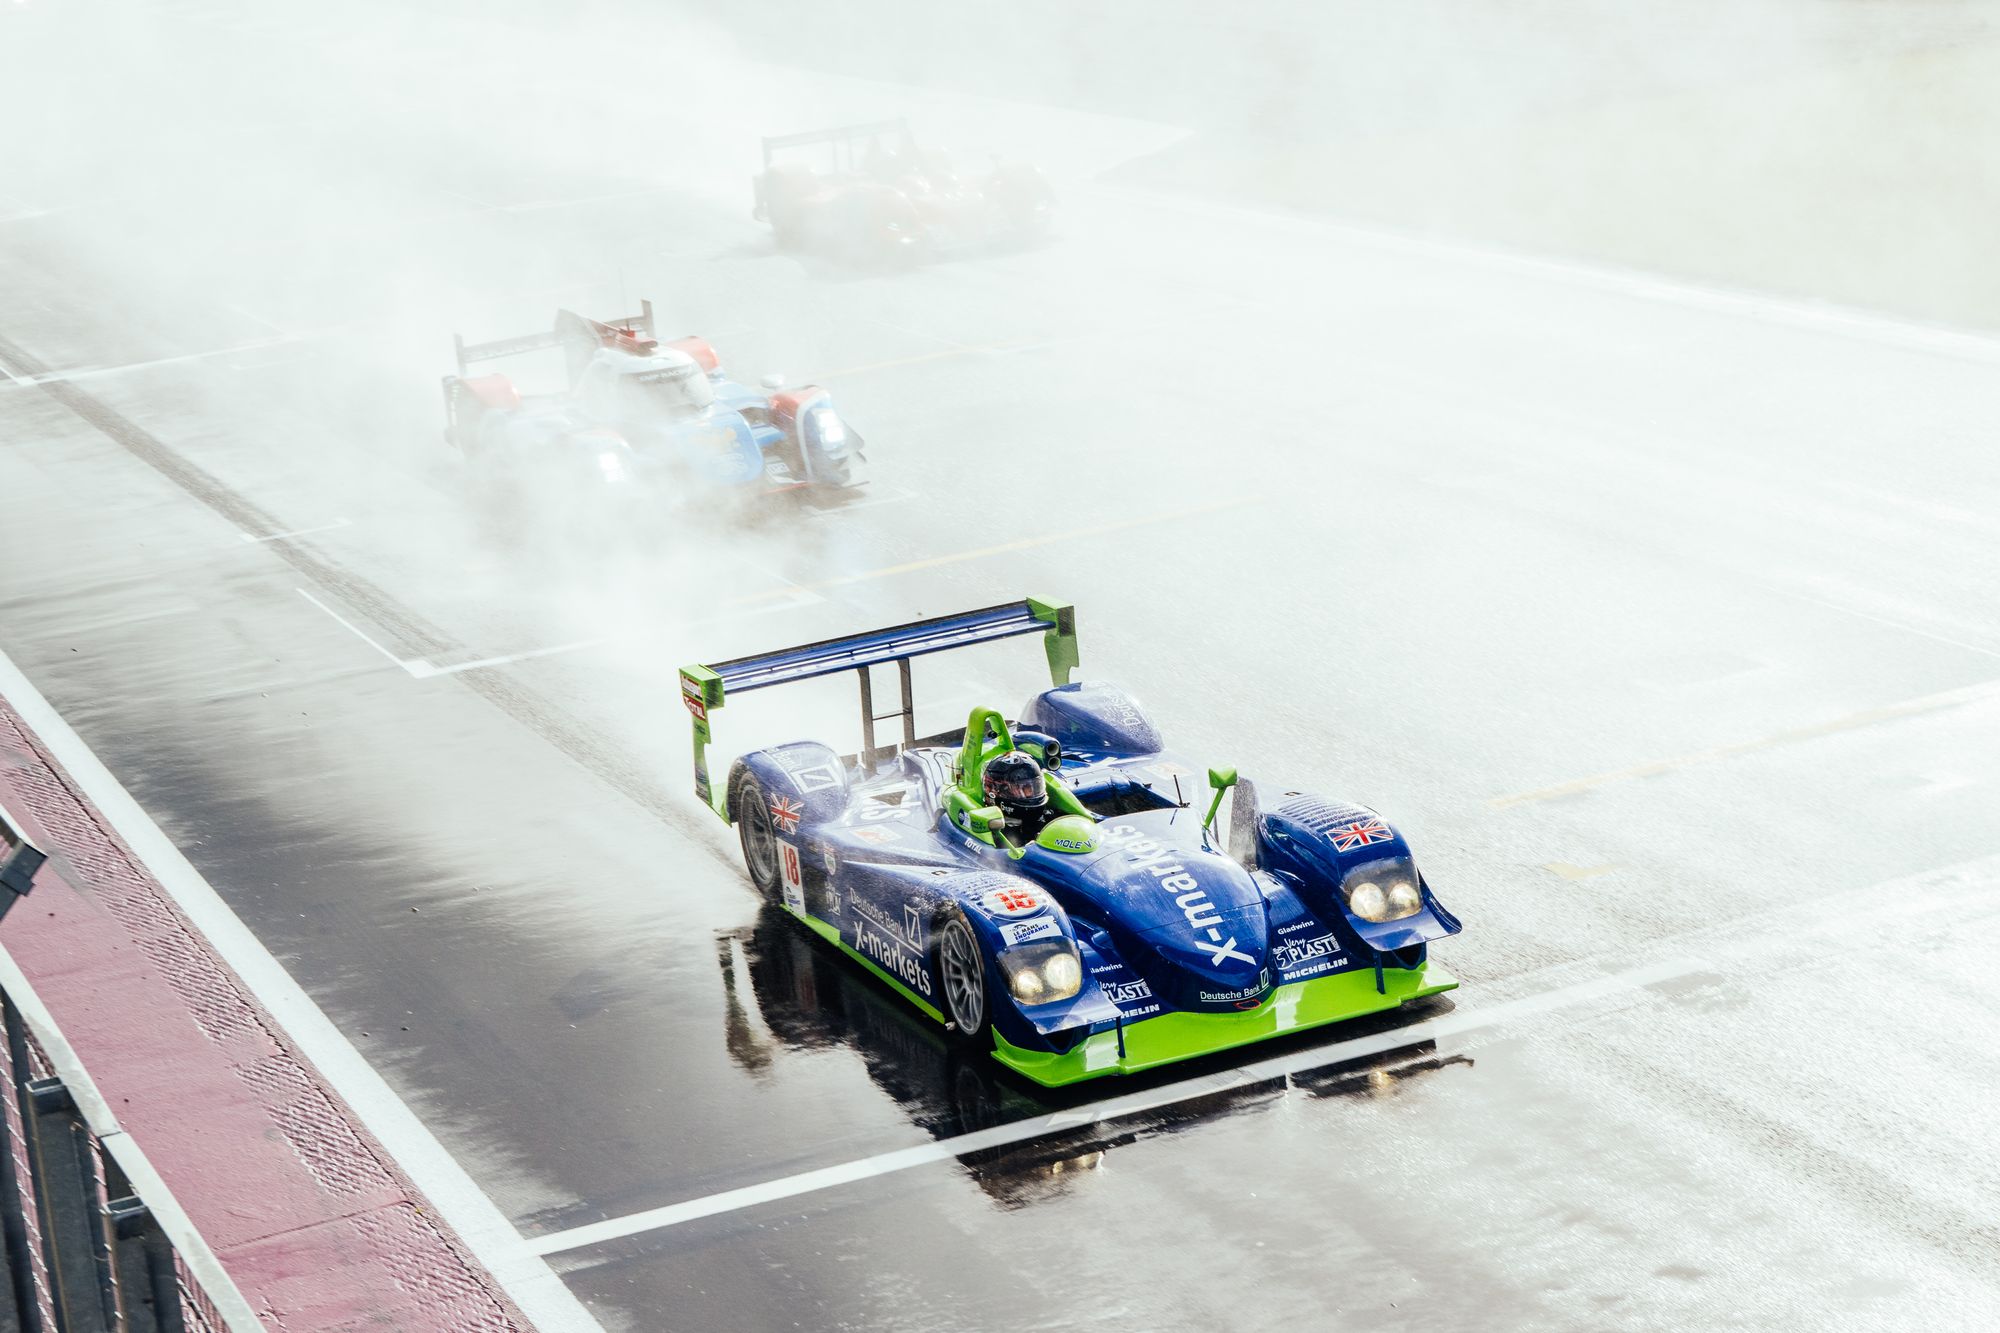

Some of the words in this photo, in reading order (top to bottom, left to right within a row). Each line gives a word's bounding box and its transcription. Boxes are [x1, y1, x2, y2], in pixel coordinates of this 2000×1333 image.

[964, 837, 982, 855] TOTAL
[1054, 838, 1082, 850] MOLE
[783, 846, 800, 886] 18
[850, 887, 884, 924] Deutsche
[884, 911, 905, 940] Bank
[1015, 924, 1050, 941] ENDURANCE
[1021, 923, 1039, 933] MANS
[1277, 920, 1315, 935] Gladwins
[1090, 963, 1123, 974] ladwins
[1283, 957, 1348, 980] MICHELIN
[1108, 984, 1142, 1002] LAST
[1200, 990, 1242, 1000] Deutsche
[1243, 984, 1260, 997] Bank
